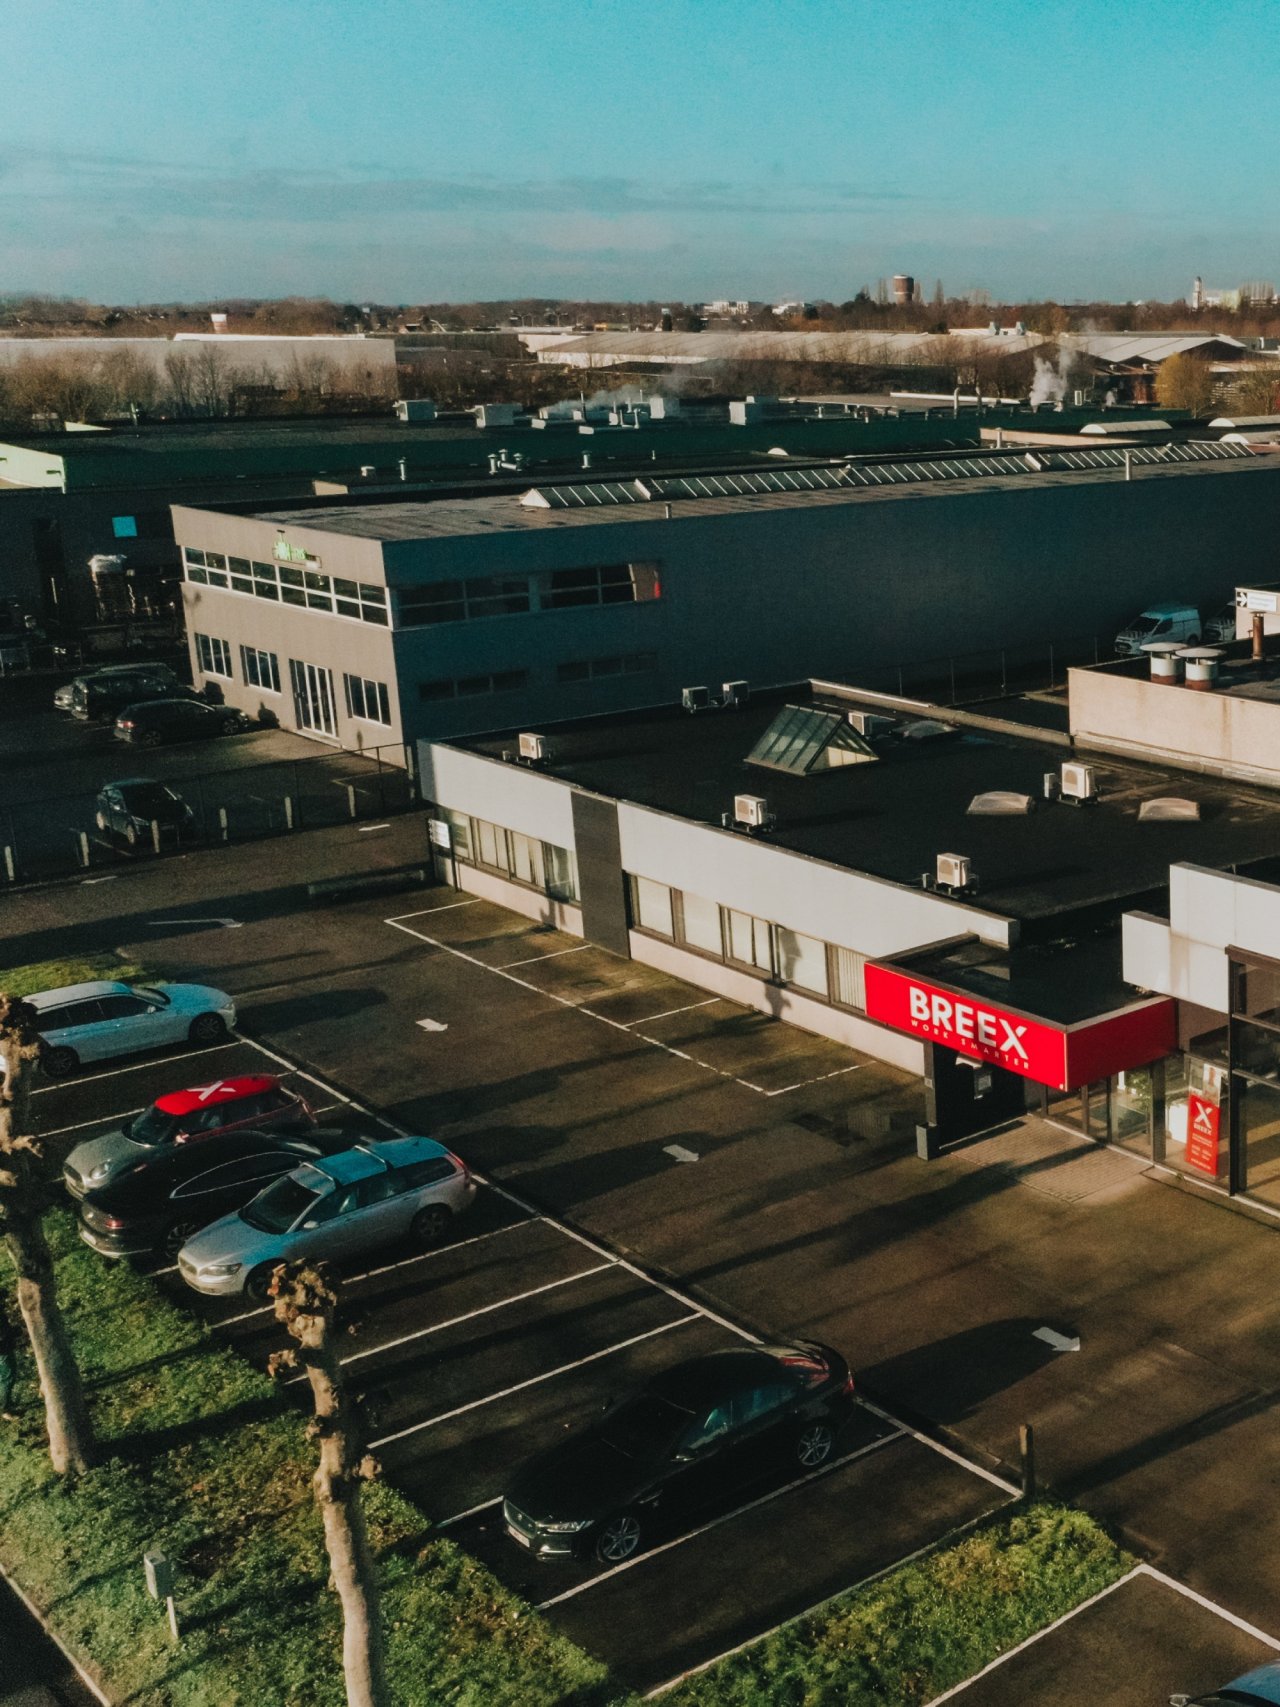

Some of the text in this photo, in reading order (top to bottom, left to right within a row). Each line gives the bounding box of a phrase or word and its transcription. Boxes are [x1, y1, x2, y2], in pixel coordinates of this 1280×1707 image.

[909, 986, 1030, 1061] BREEX
[911, 1019, 1030, 1071] WORK SMARTER
